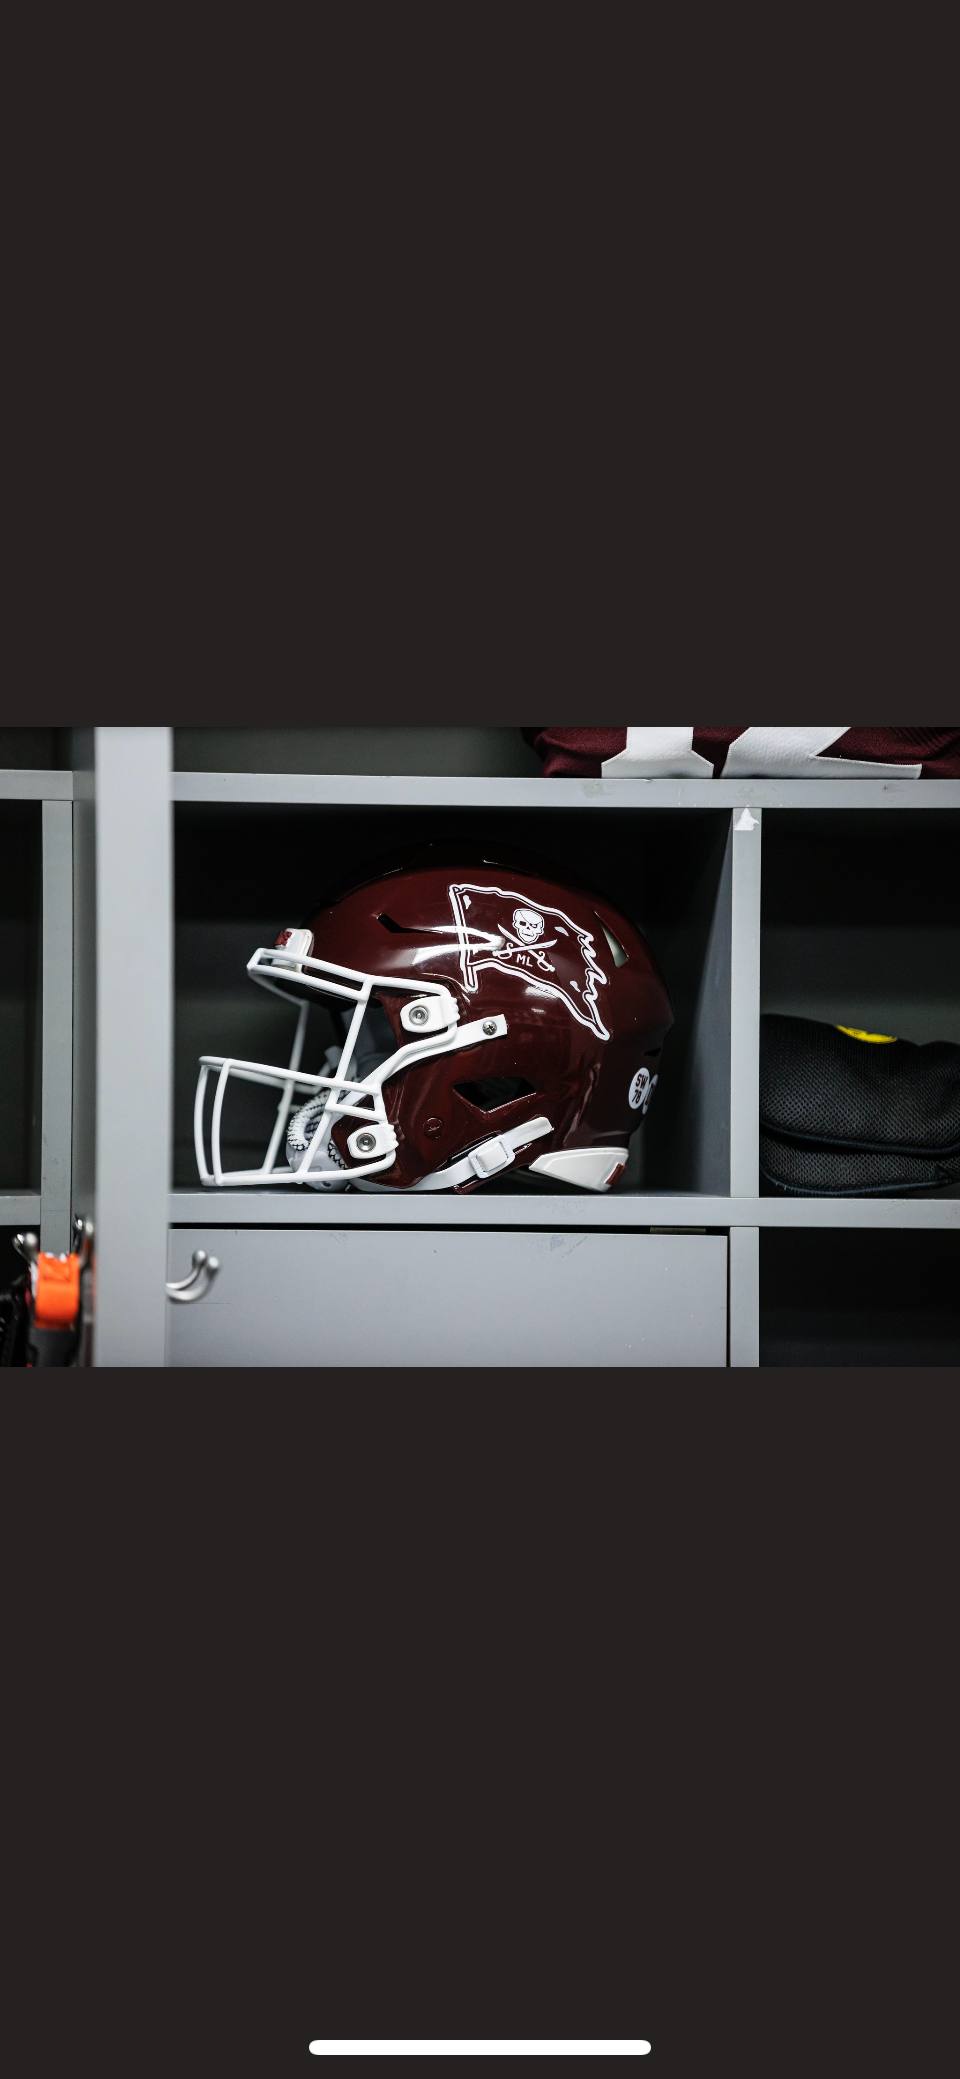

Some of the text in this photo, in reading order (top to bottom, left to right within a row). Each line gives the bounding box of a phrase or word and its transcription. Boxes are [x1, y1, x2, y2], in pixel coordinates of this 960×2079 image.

[516, 953, 533, 967] ML
[635, 1073, 648, 1090] SW
[632, 1089, 642, 1104] 78
